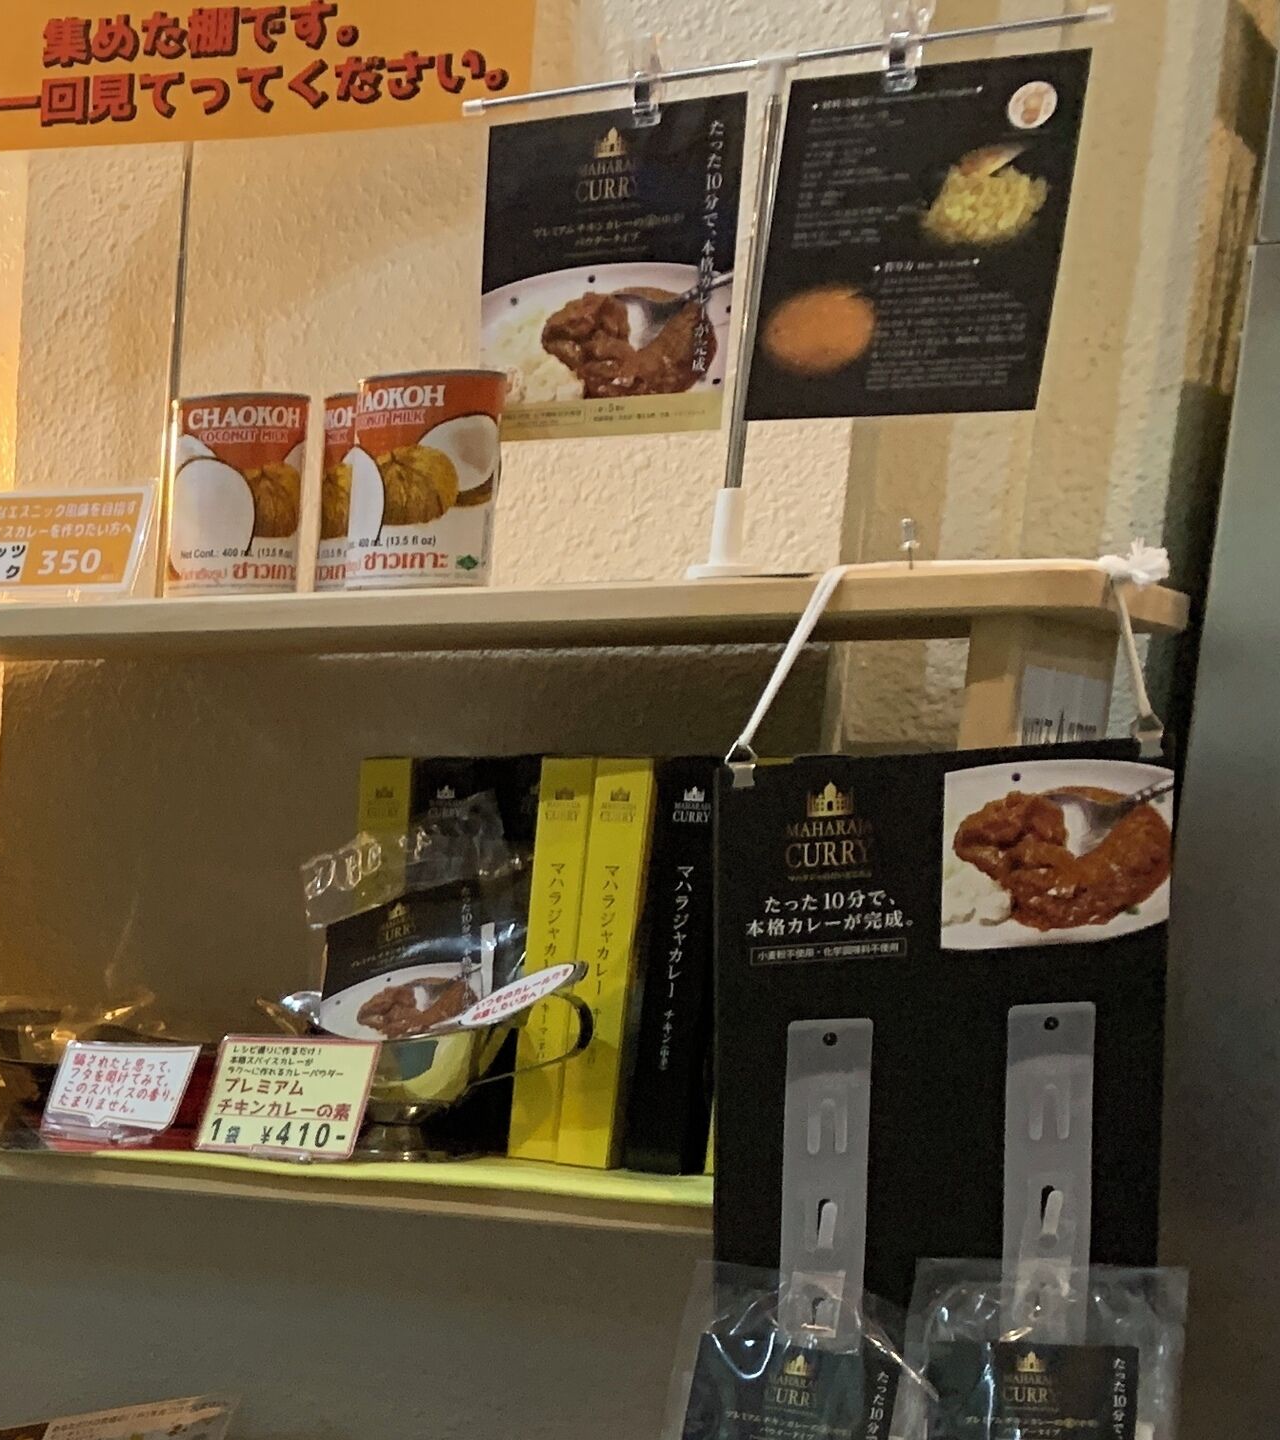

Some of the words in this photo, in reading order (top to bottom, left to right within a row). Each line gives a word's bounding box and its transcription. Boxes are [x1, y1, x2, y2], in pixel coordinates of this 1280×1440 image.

[41, 1, 361, 69] 集めた棚です。
[188, 406, 300, 431] CHAOKOH
[392, 409, 426, 425] MILK
[37, 549, 101, 575] 350
[672, 810, 710, 824] CURRY
[764, 890, 896, 914] たった10分で、
[595, 864, 621, 998] マハラジャカレー
[667, 865, 695, 999] マハラジャカレー
[746, 909, 913, 937] 本格カレーが完成。
[225, 1078, 304, 1096] プレミアム
[218, 1098, 352, 1121] チキンカレーの素
[260, 1122, 346, 1148] ¥410-
